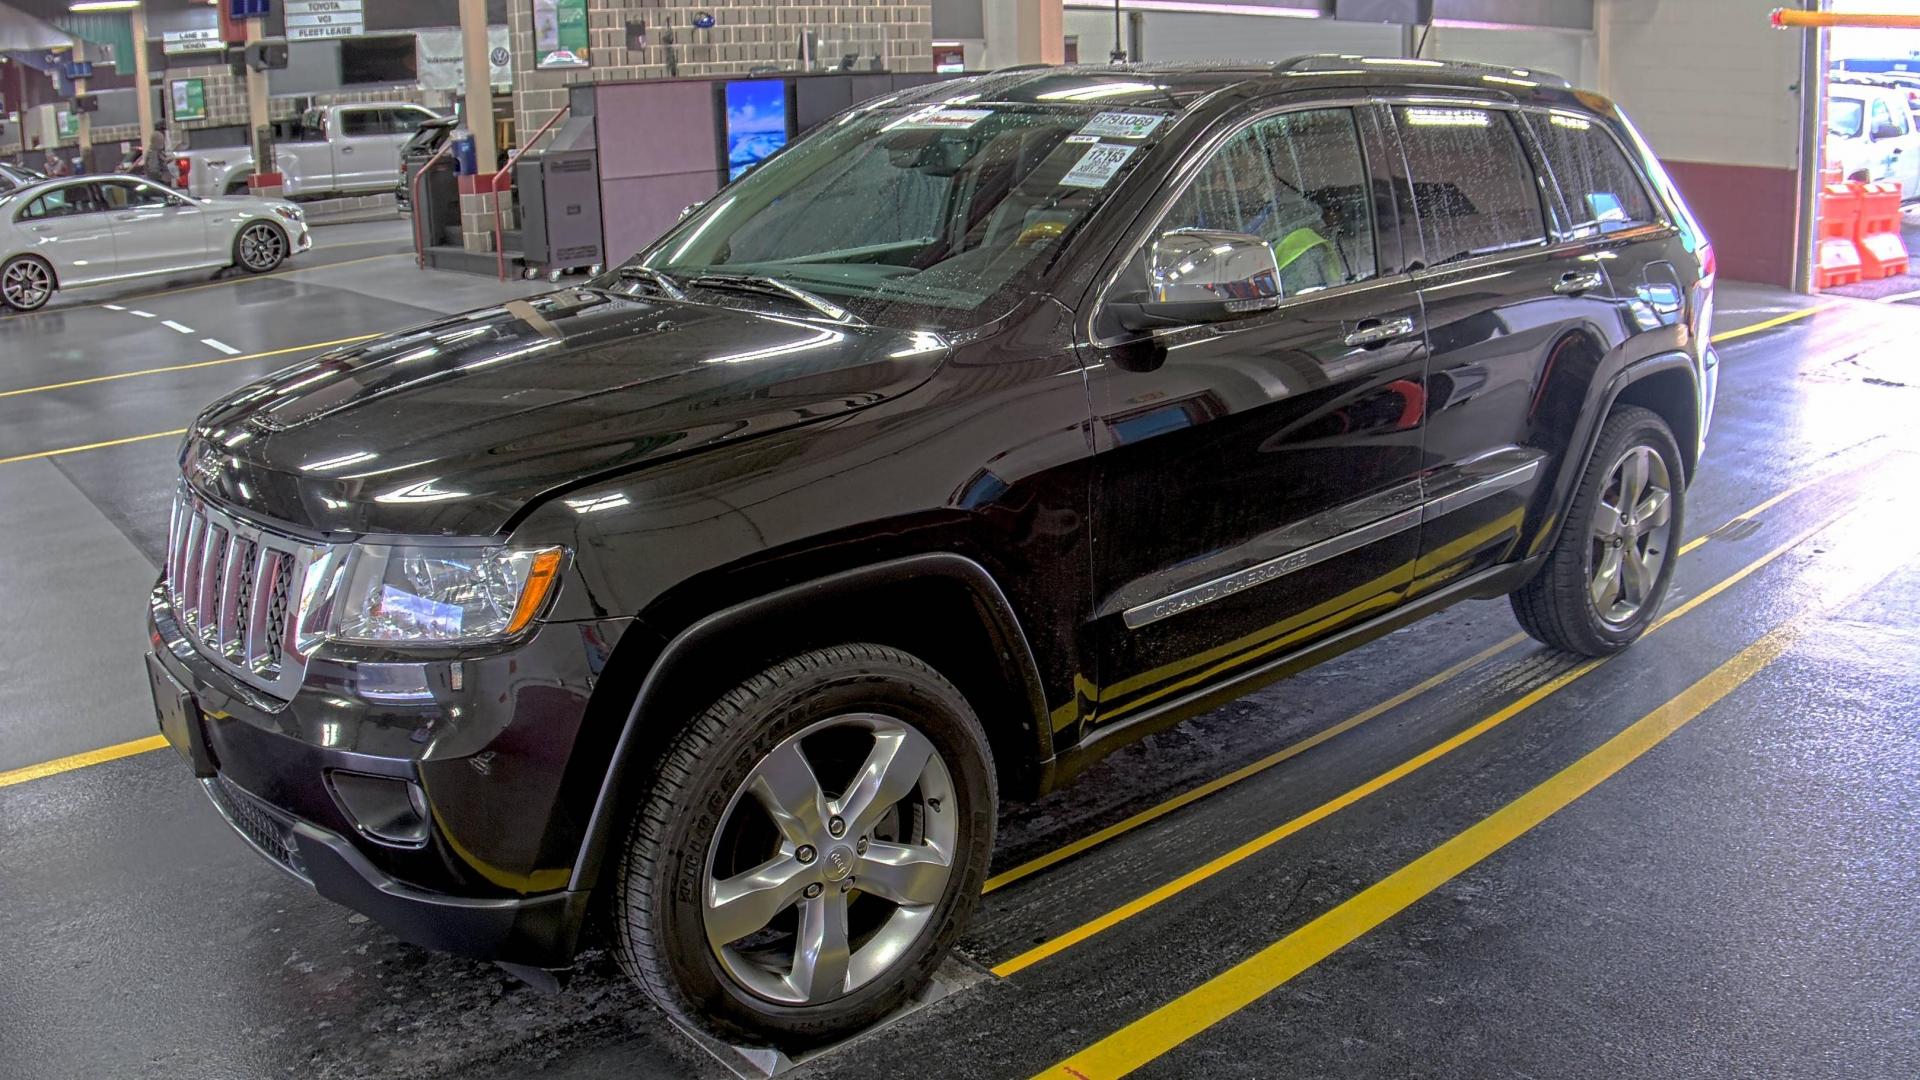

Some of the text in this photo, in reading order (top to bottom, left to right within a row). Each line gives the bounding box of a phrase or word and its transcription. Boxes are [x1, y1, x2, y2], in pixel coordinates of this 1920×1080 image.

[308, 2, 340, 11] TOYOTA
[179, 31, 198, 39] LANE
[298, 27, 352, 37] FLEET LEASE
[1153, 553, 1308, 618] GRAND CHEROKEE
